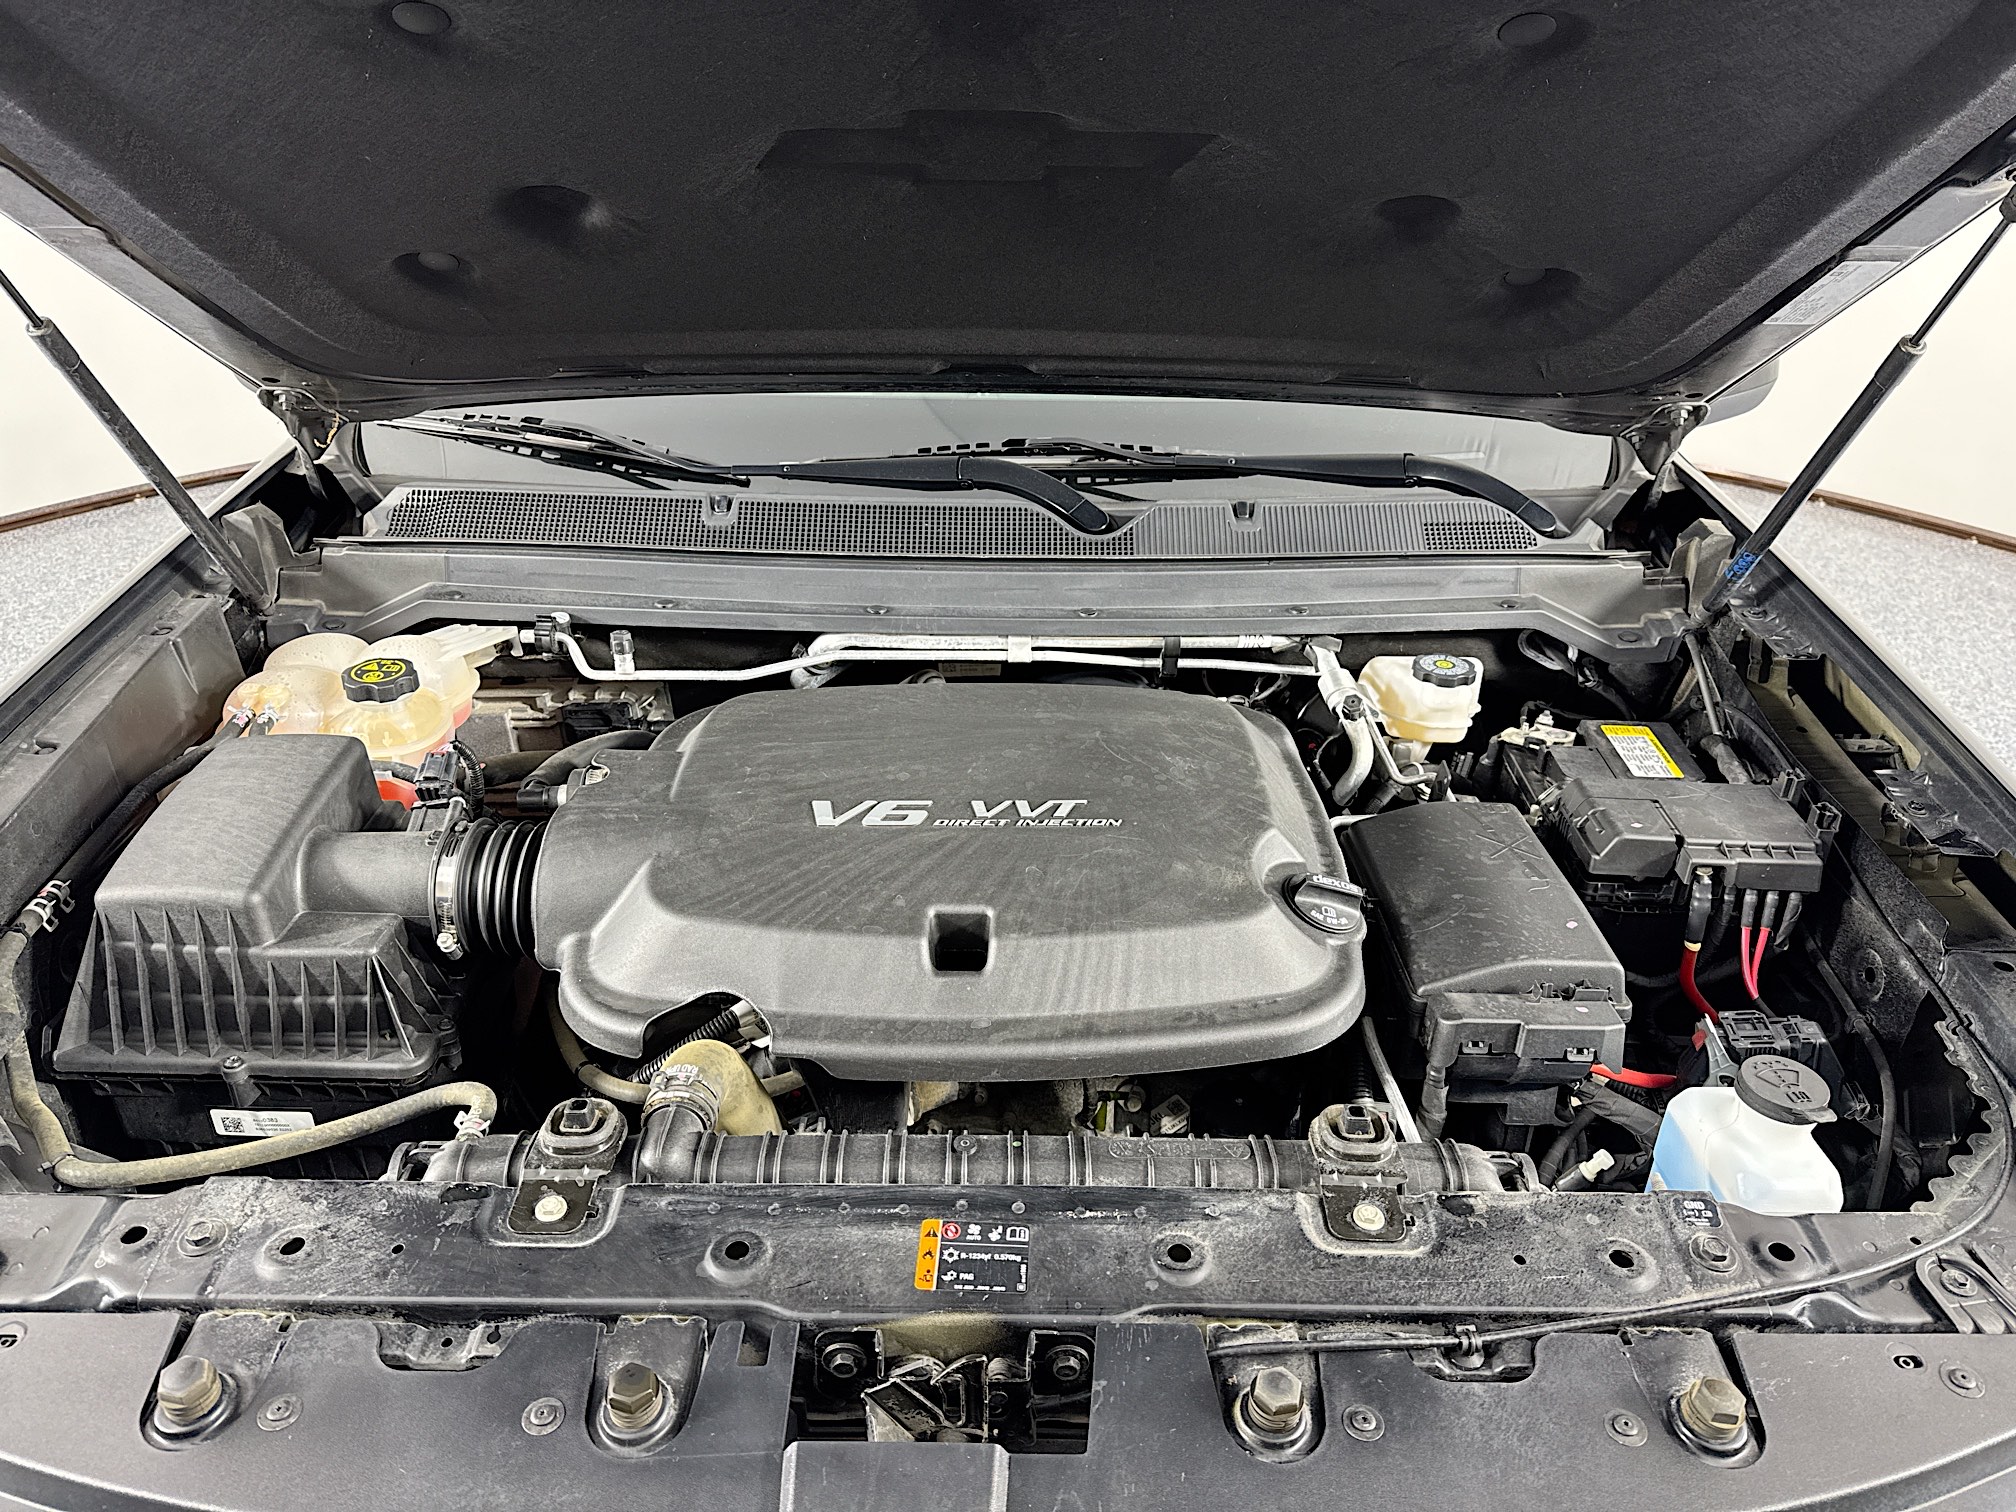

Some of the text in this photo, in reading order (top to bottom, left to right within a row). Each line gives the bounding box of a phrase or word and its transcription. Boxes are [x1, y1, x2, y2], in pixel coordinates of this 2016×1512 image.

[811, 799, 1088, 828] V6 VVT
[932, 818, 1124, 828] DIRECT INJECTION
[1312, 874, 1359, 893] dexos
[681, 1064, 699, 1074] RAD
[1683, 1200, 1705, 1210] GND
[960, 1252, 991, 1262] R-1234yf
[959, 1272, 974, 1281] PAG
